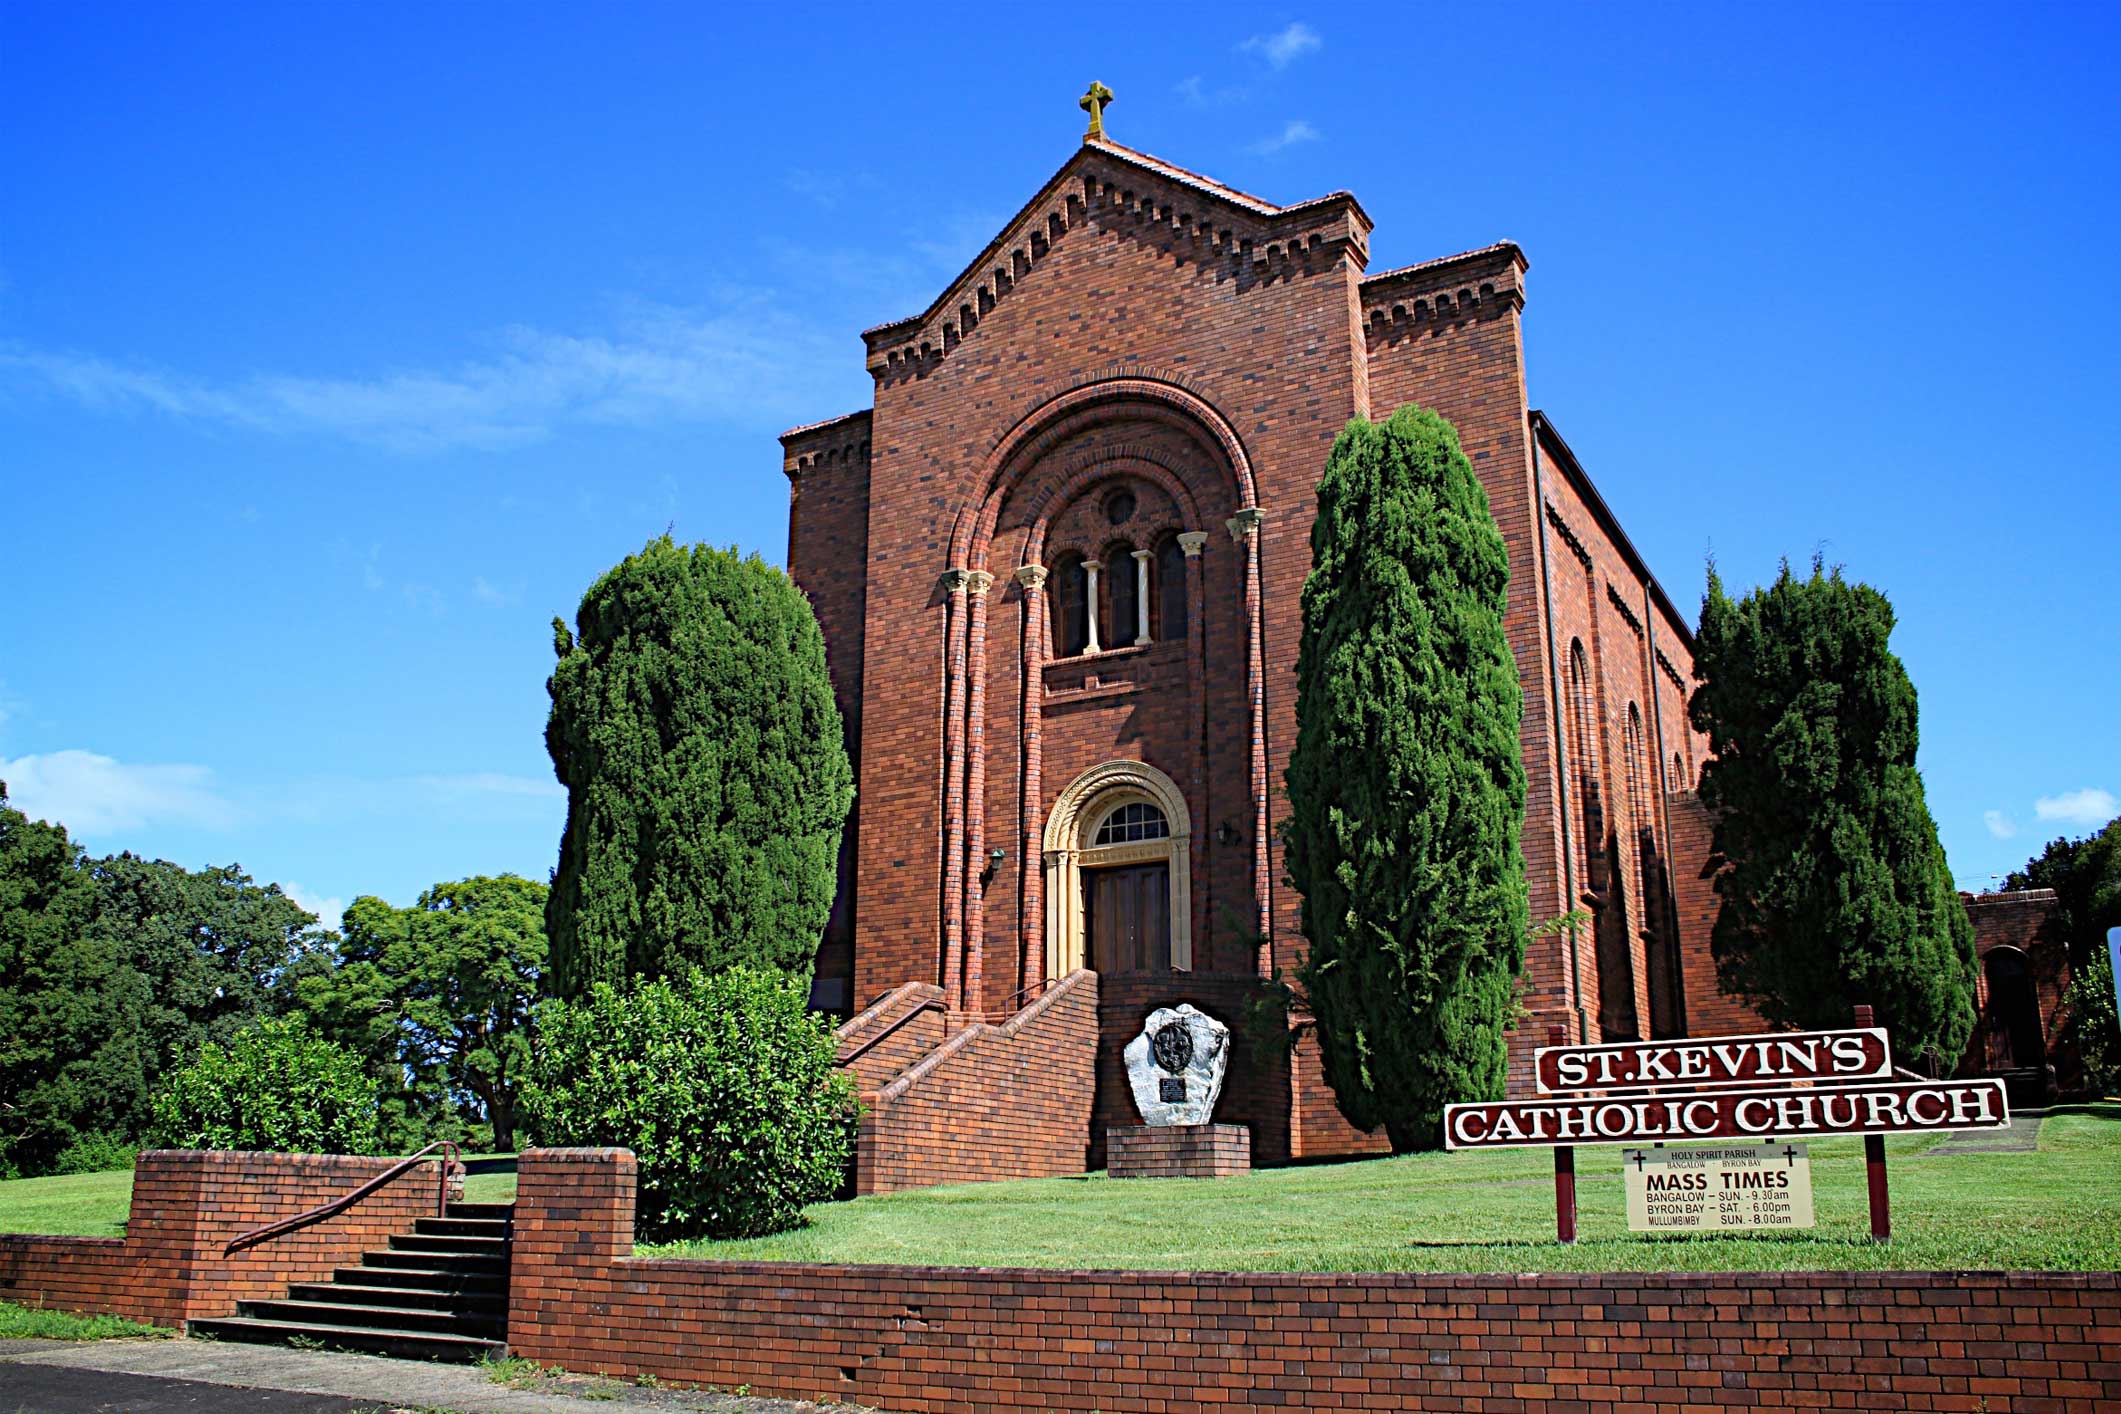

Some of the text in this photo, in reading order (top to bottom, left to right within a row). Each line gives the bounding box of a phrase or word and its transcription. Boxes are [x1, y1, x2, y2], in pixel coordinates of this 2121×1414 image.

[1454, 1087, 1998, 1143] CATHOLIC CHURCH
[1671, 1149, 1756, 1160] HOLY SPIRIT PARISH
[1667, 1161, 1706, 1169] BANGALOW
[1722, 1159, 1746, 1168] BYRON
[1748, 1159, 1761, 1167] BAY
[1646, 1170, 1789, 1191] MASS TIMES
[1646, 1191, 1705, 1203] BANGALOW
[1718, 1191, 1744, 1201] SUN.
[1647, 1204, 1683, 1215] BYRON
[1685, 1204, 1705, 1214] BAY
[1719, 1203, 1741, 1213] SAT.
[1752, 1202, 1791, 1214] 6.00pm
[1648, 1215, 1700, 1226] MULLUMBIMBY
[1720, 1214, 1746, 1225] SUN.
